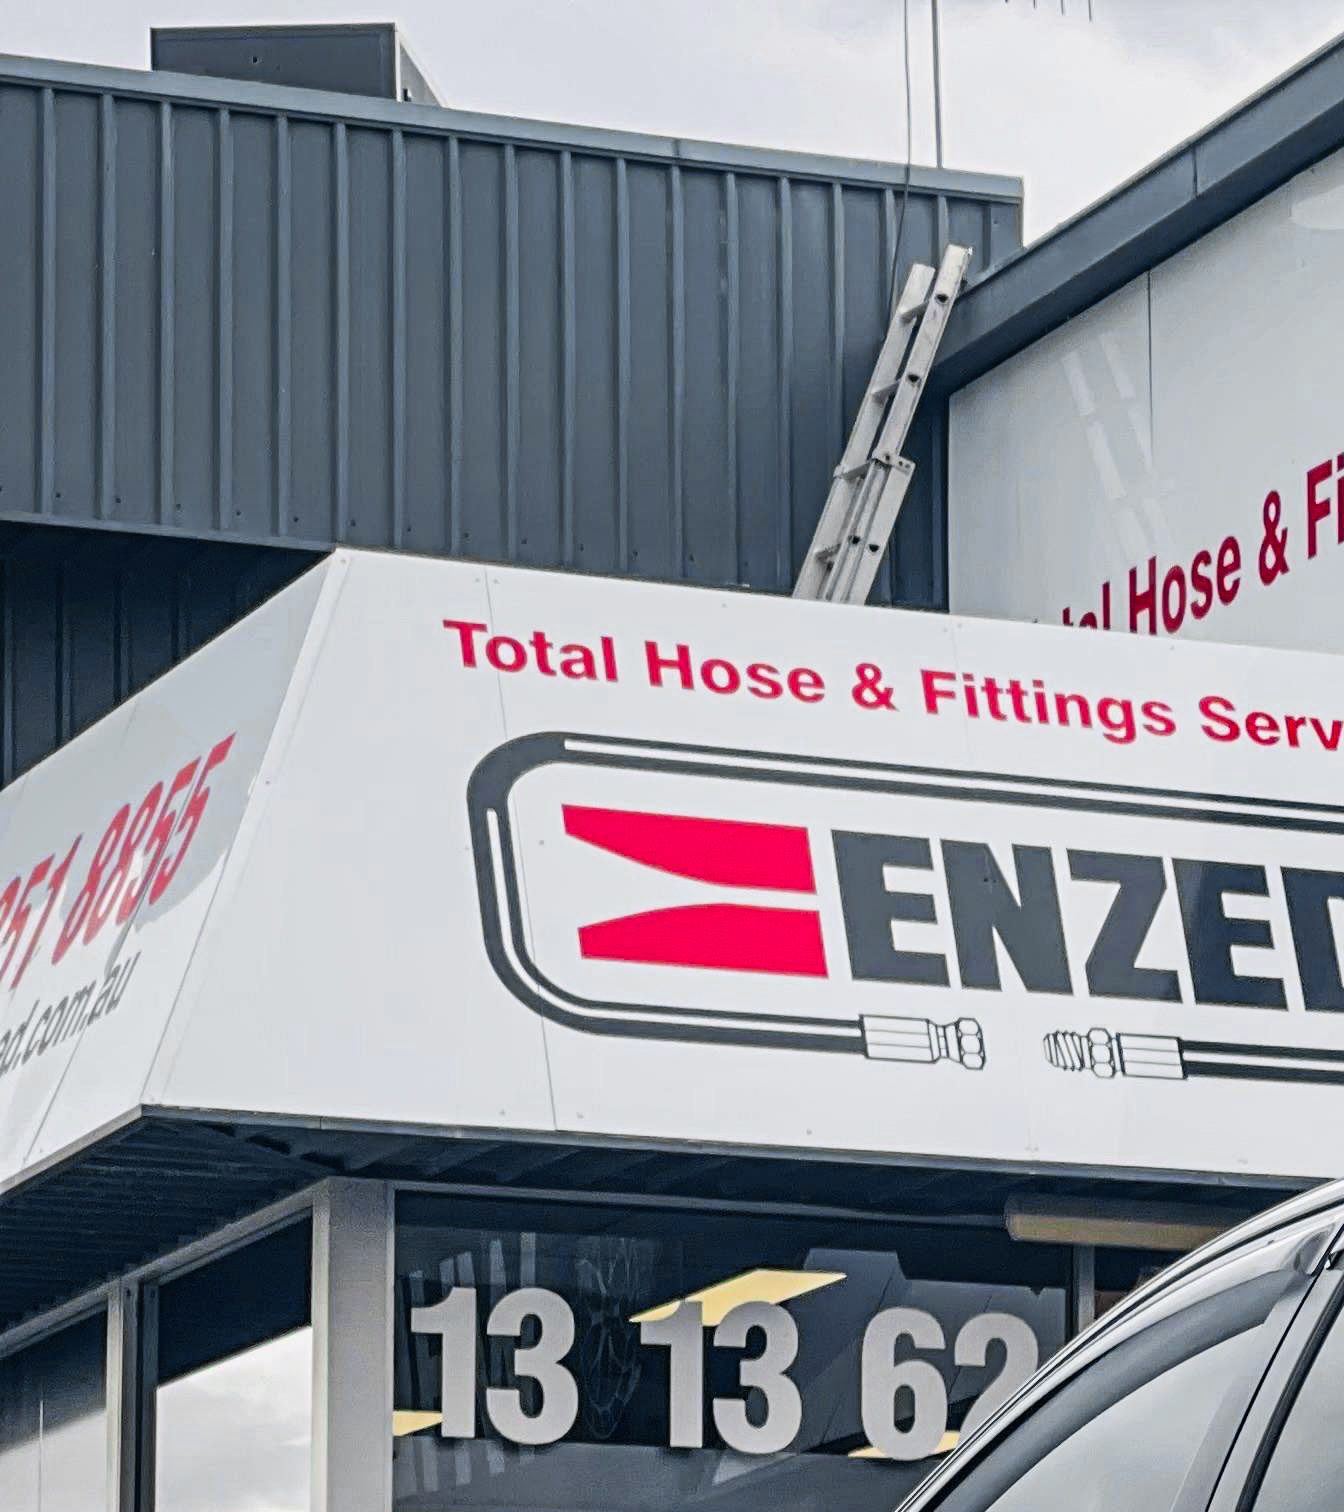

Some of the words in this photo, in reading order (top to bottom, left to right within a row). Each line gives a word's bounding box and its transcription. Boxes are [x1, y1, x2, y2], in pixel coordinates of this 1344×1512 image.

[1128, 535, 1243, 636] Hose
[1258, 490, 1290, 587] &
[443, 619, 619, 684] Total
[645, 640, 826, 706] Hose
[851, 663, 894, 712] &
[921, 669, 1177, 746] Fittings
[51, 731, 237, 967] 8855
[410, 1285, 580, 1446] 13
[640, 1299, 803, 1456] 13
